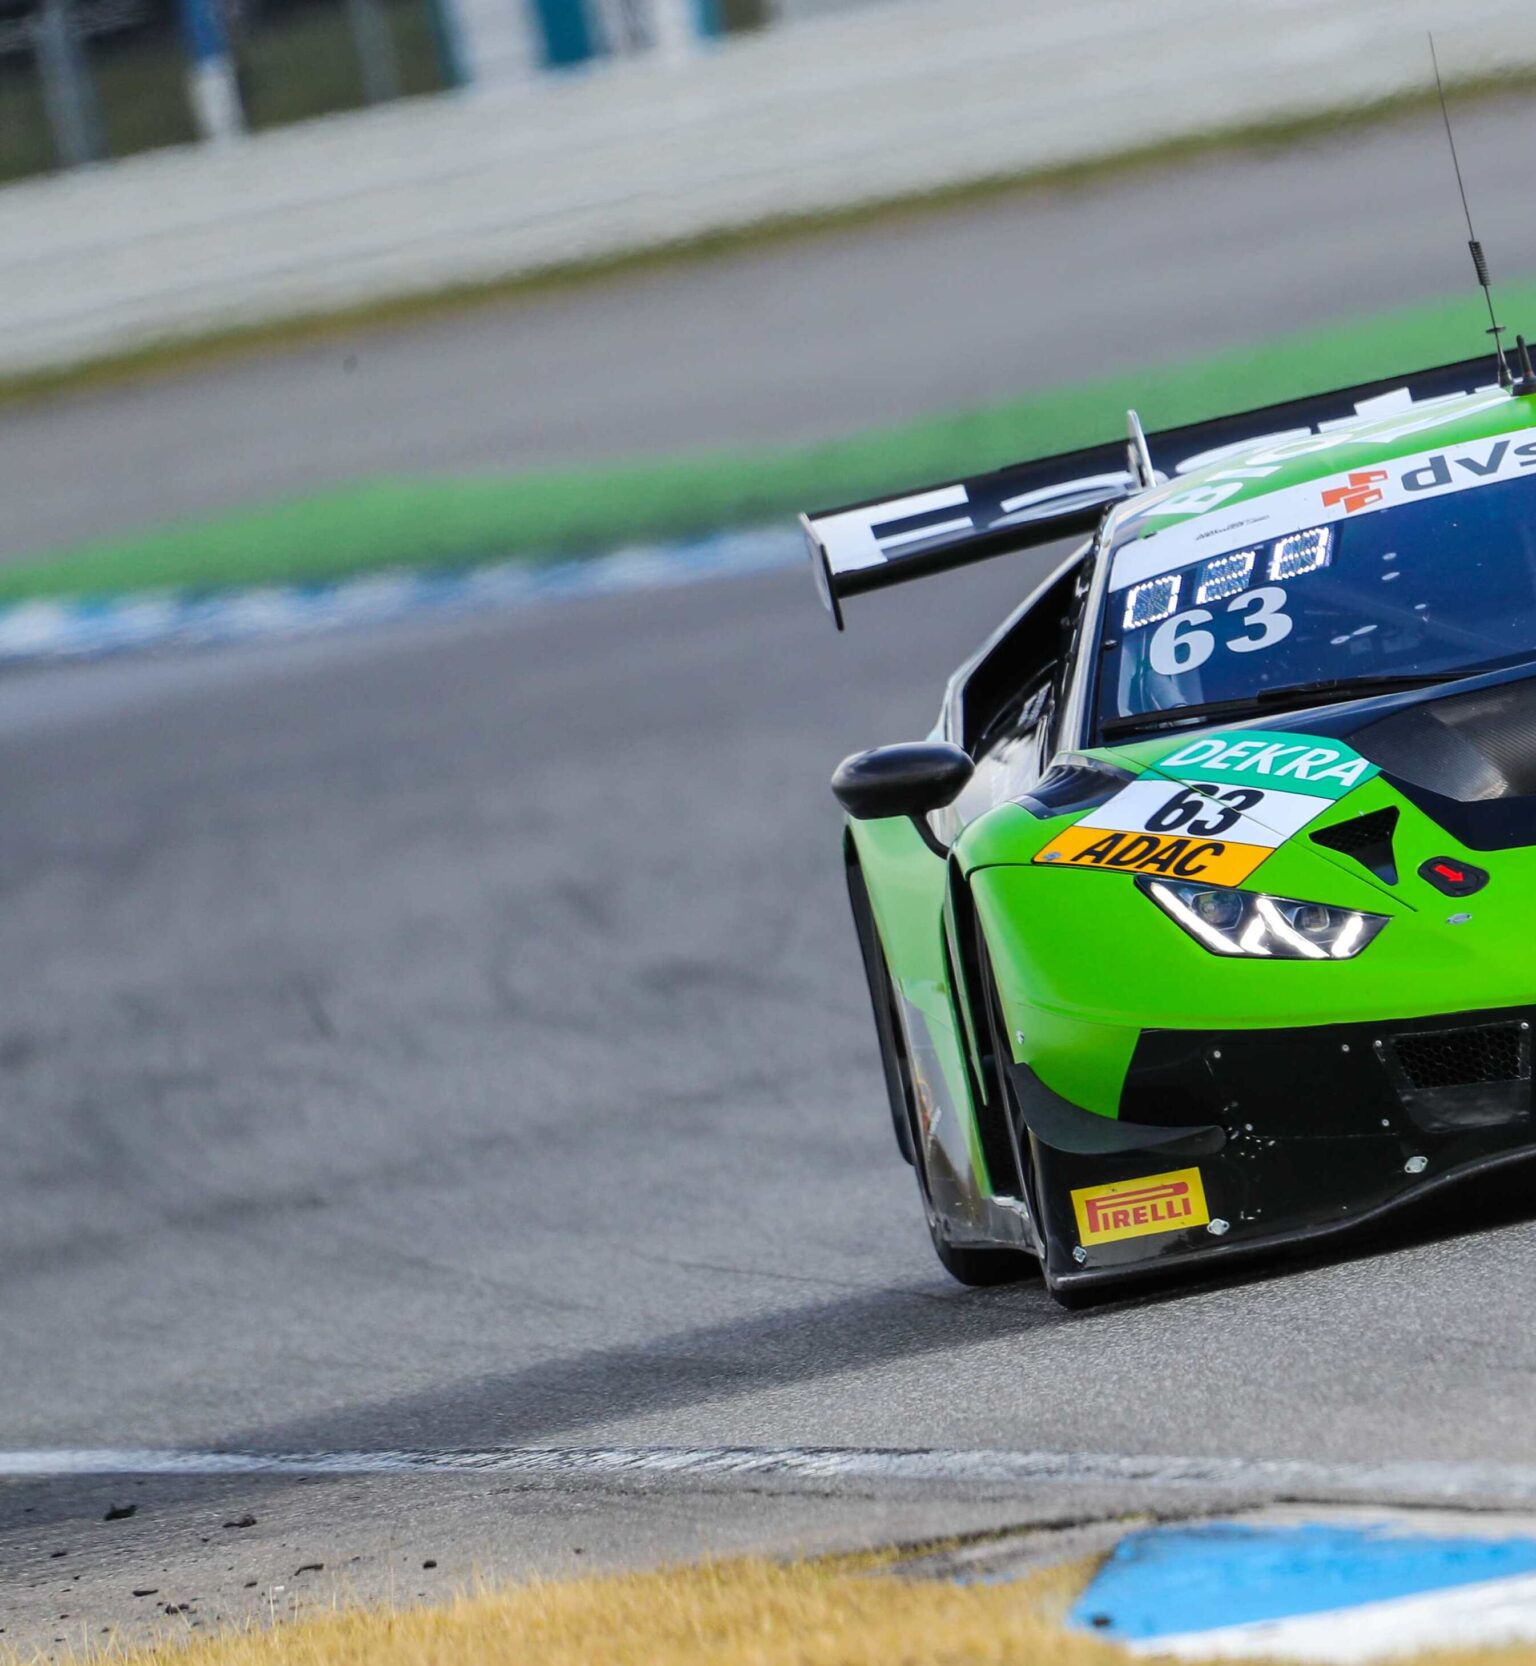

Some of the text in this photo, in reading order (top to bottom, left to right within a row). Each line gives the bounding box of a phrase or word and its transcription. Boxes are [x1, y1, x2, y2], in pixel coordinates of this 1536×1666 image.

[1149, 586, 1293, 676] 63
[1160, 739, 1370, 787] DEKRA
[1144, 783, 1265, 837] 63
[1071, 832, 1225, 876] ADAC
[1085, 1180, 1193, 1233] PIRELLI
